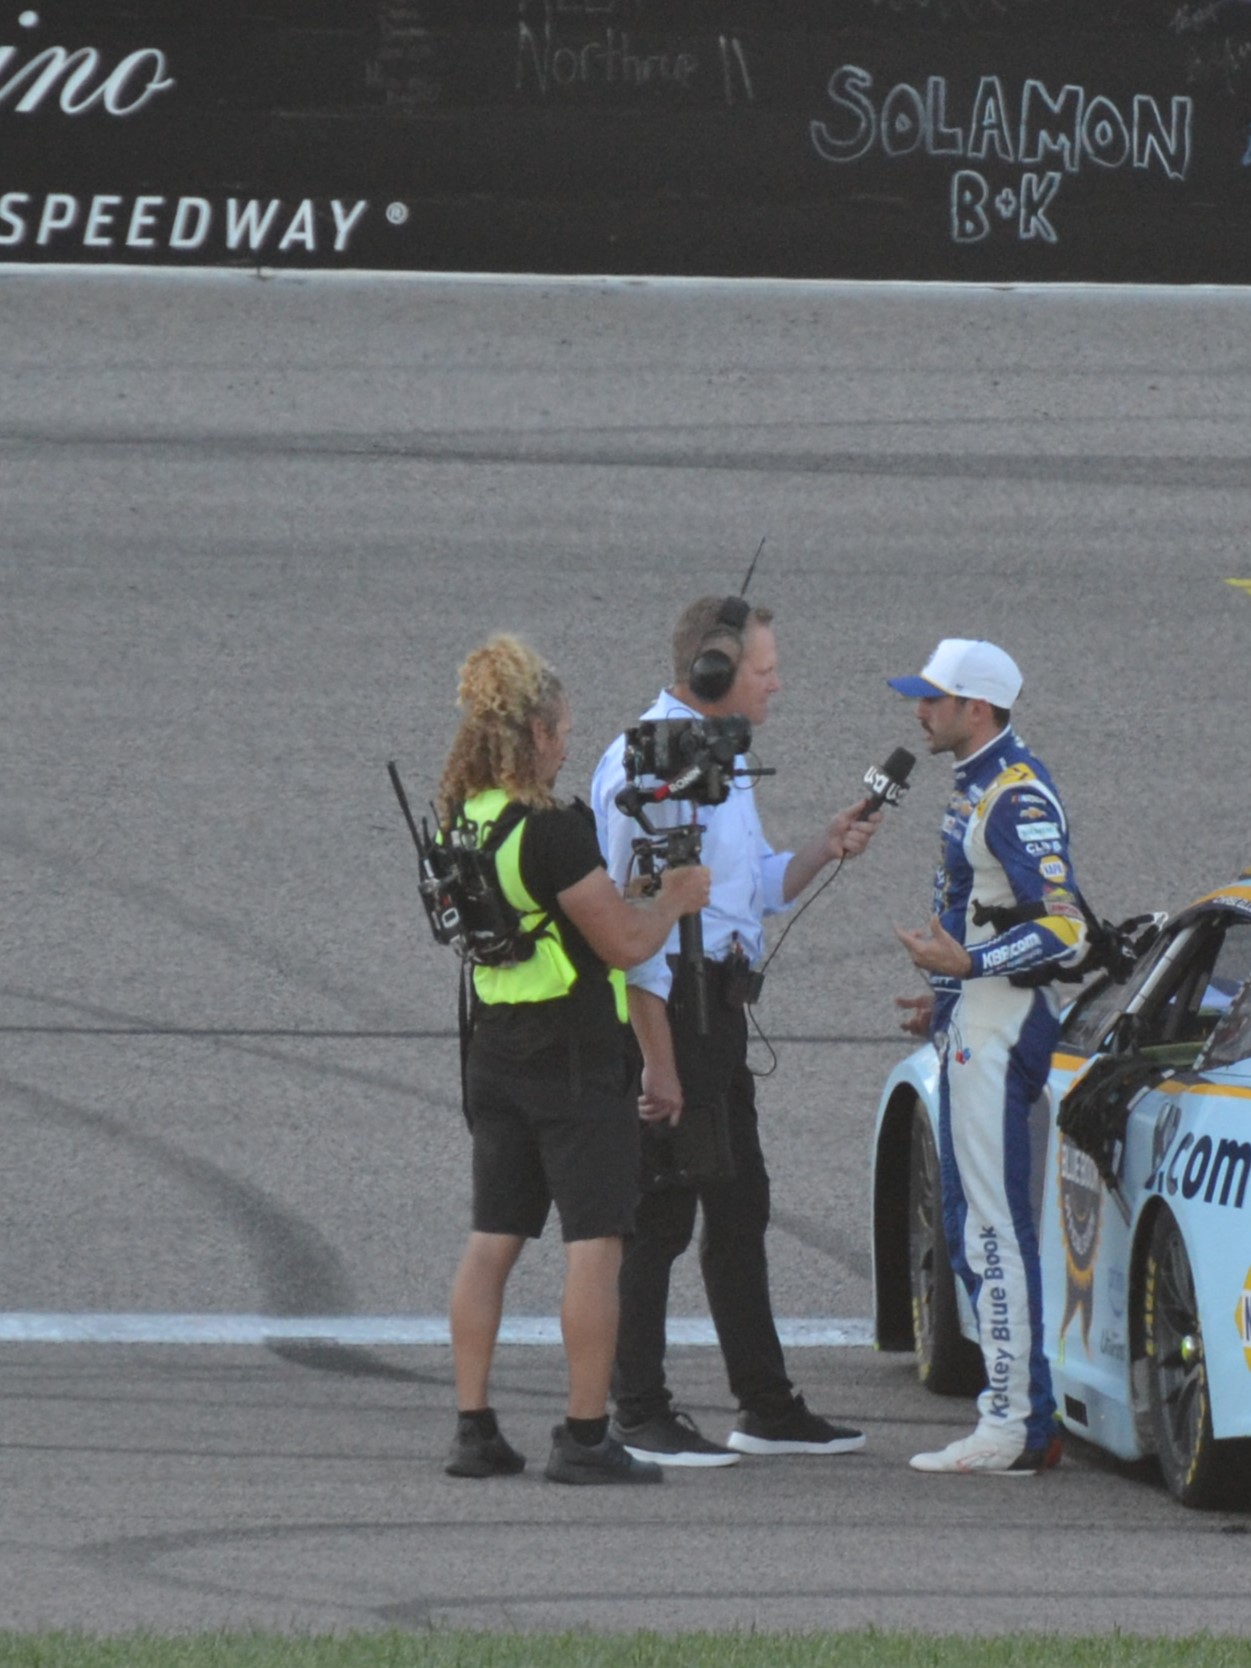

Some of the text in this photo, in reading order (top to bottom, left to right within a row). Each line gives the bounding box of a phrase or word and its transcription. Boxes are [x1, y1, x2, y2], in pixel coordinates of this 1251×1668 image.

[811, 64, 1192, 180] SOLAMON
[0, 192, 367, 252] SPEEDWAY
[979, 1224, 1005, 1280] Book
[990, 1280, 1013, 1342] Blue
